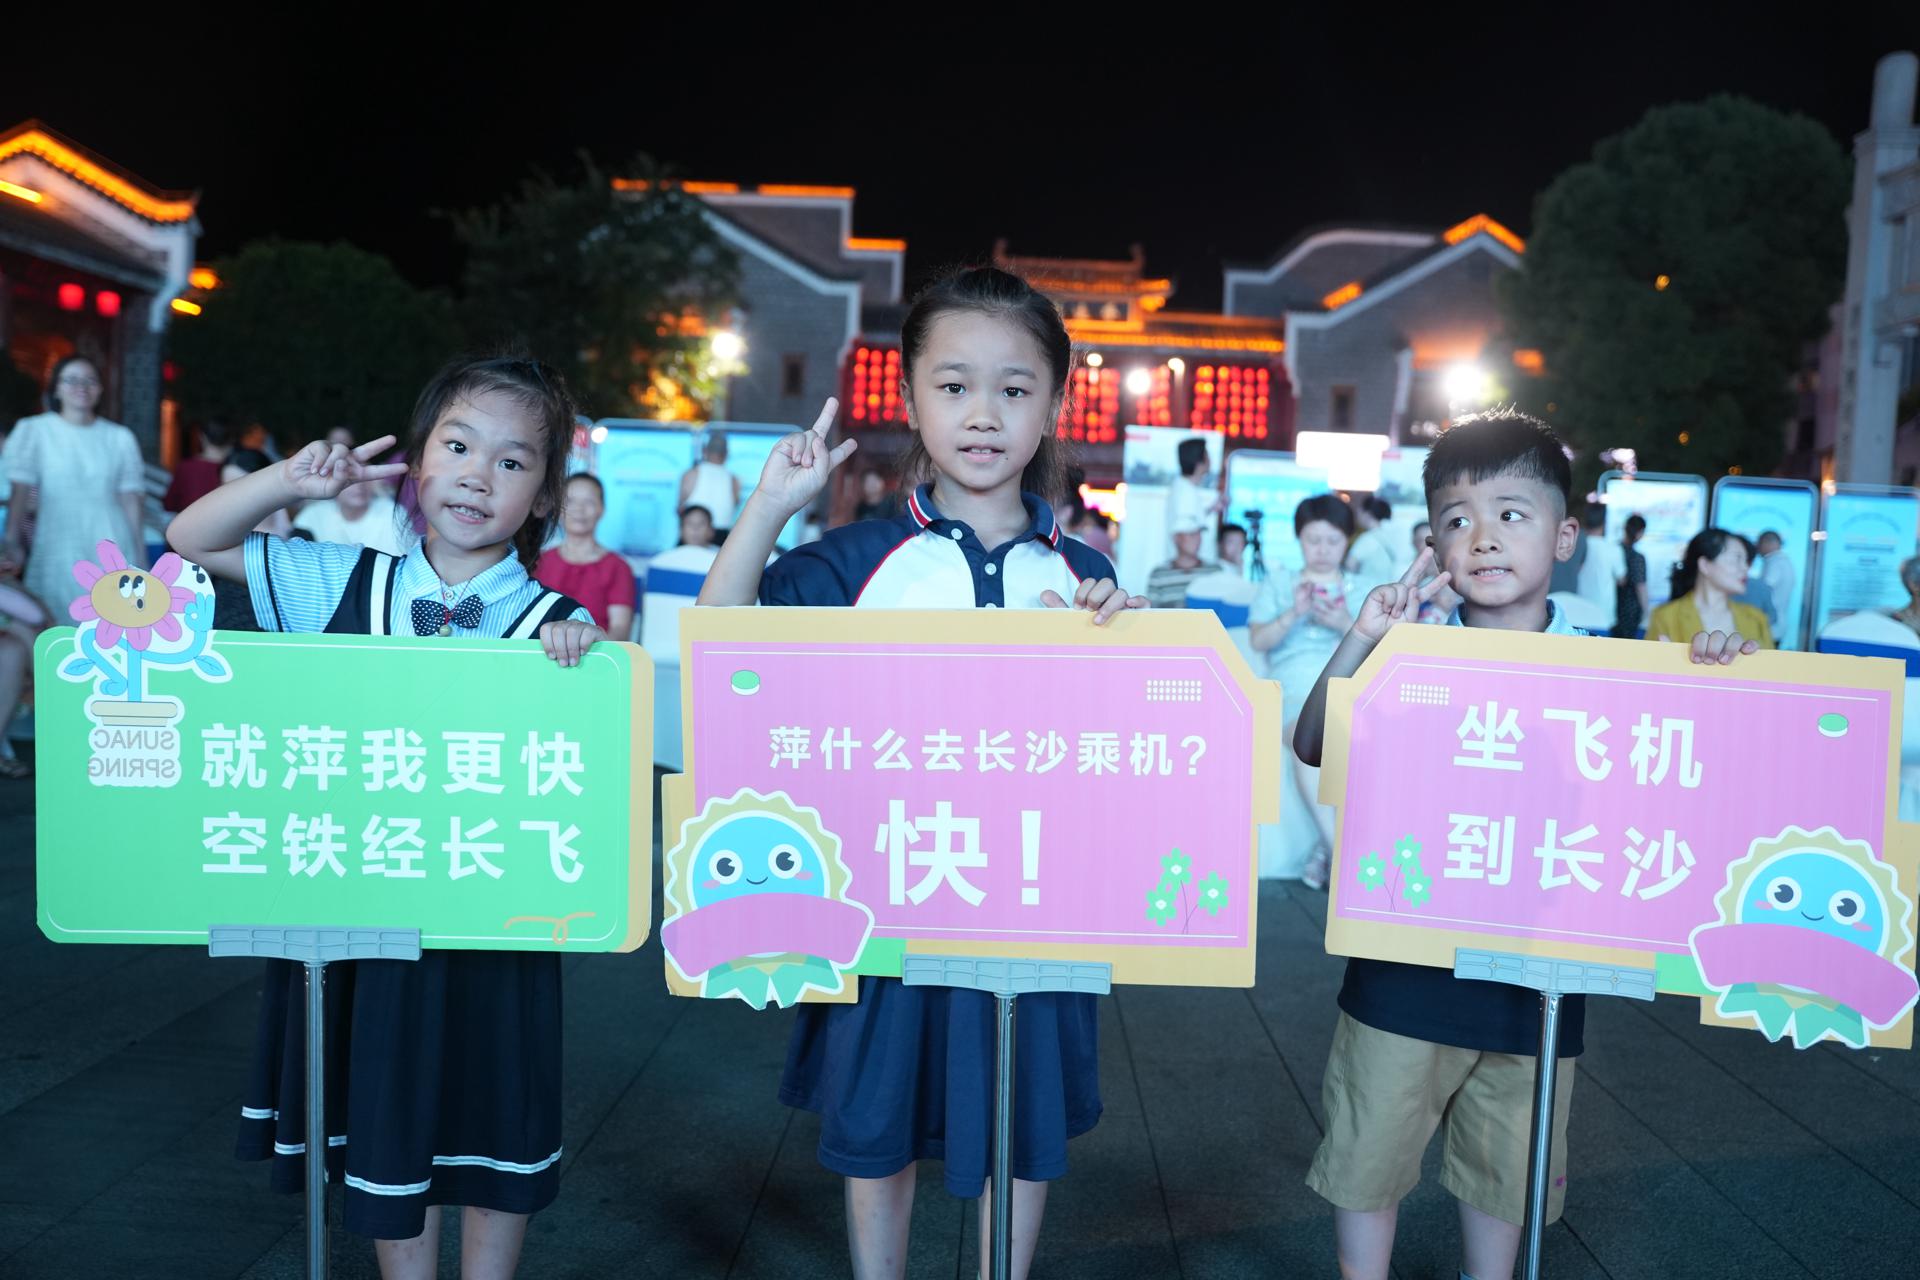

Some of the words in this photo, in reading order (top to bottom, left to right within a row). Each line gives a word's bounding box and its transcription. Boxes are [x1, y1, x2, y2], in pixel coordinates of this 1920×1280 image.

[201, 722, 585, 797] 就萍我更快
[768, 725, 1207, 776] 萍什么去长沙乘机？
[1453, 700, 1703, 788] 坐飞机
[202, 811, 585, 883] 空铁经长飞
[874, 799, 1042, 907] 快！
[1443, 813, 1697, 901] 到长沙
